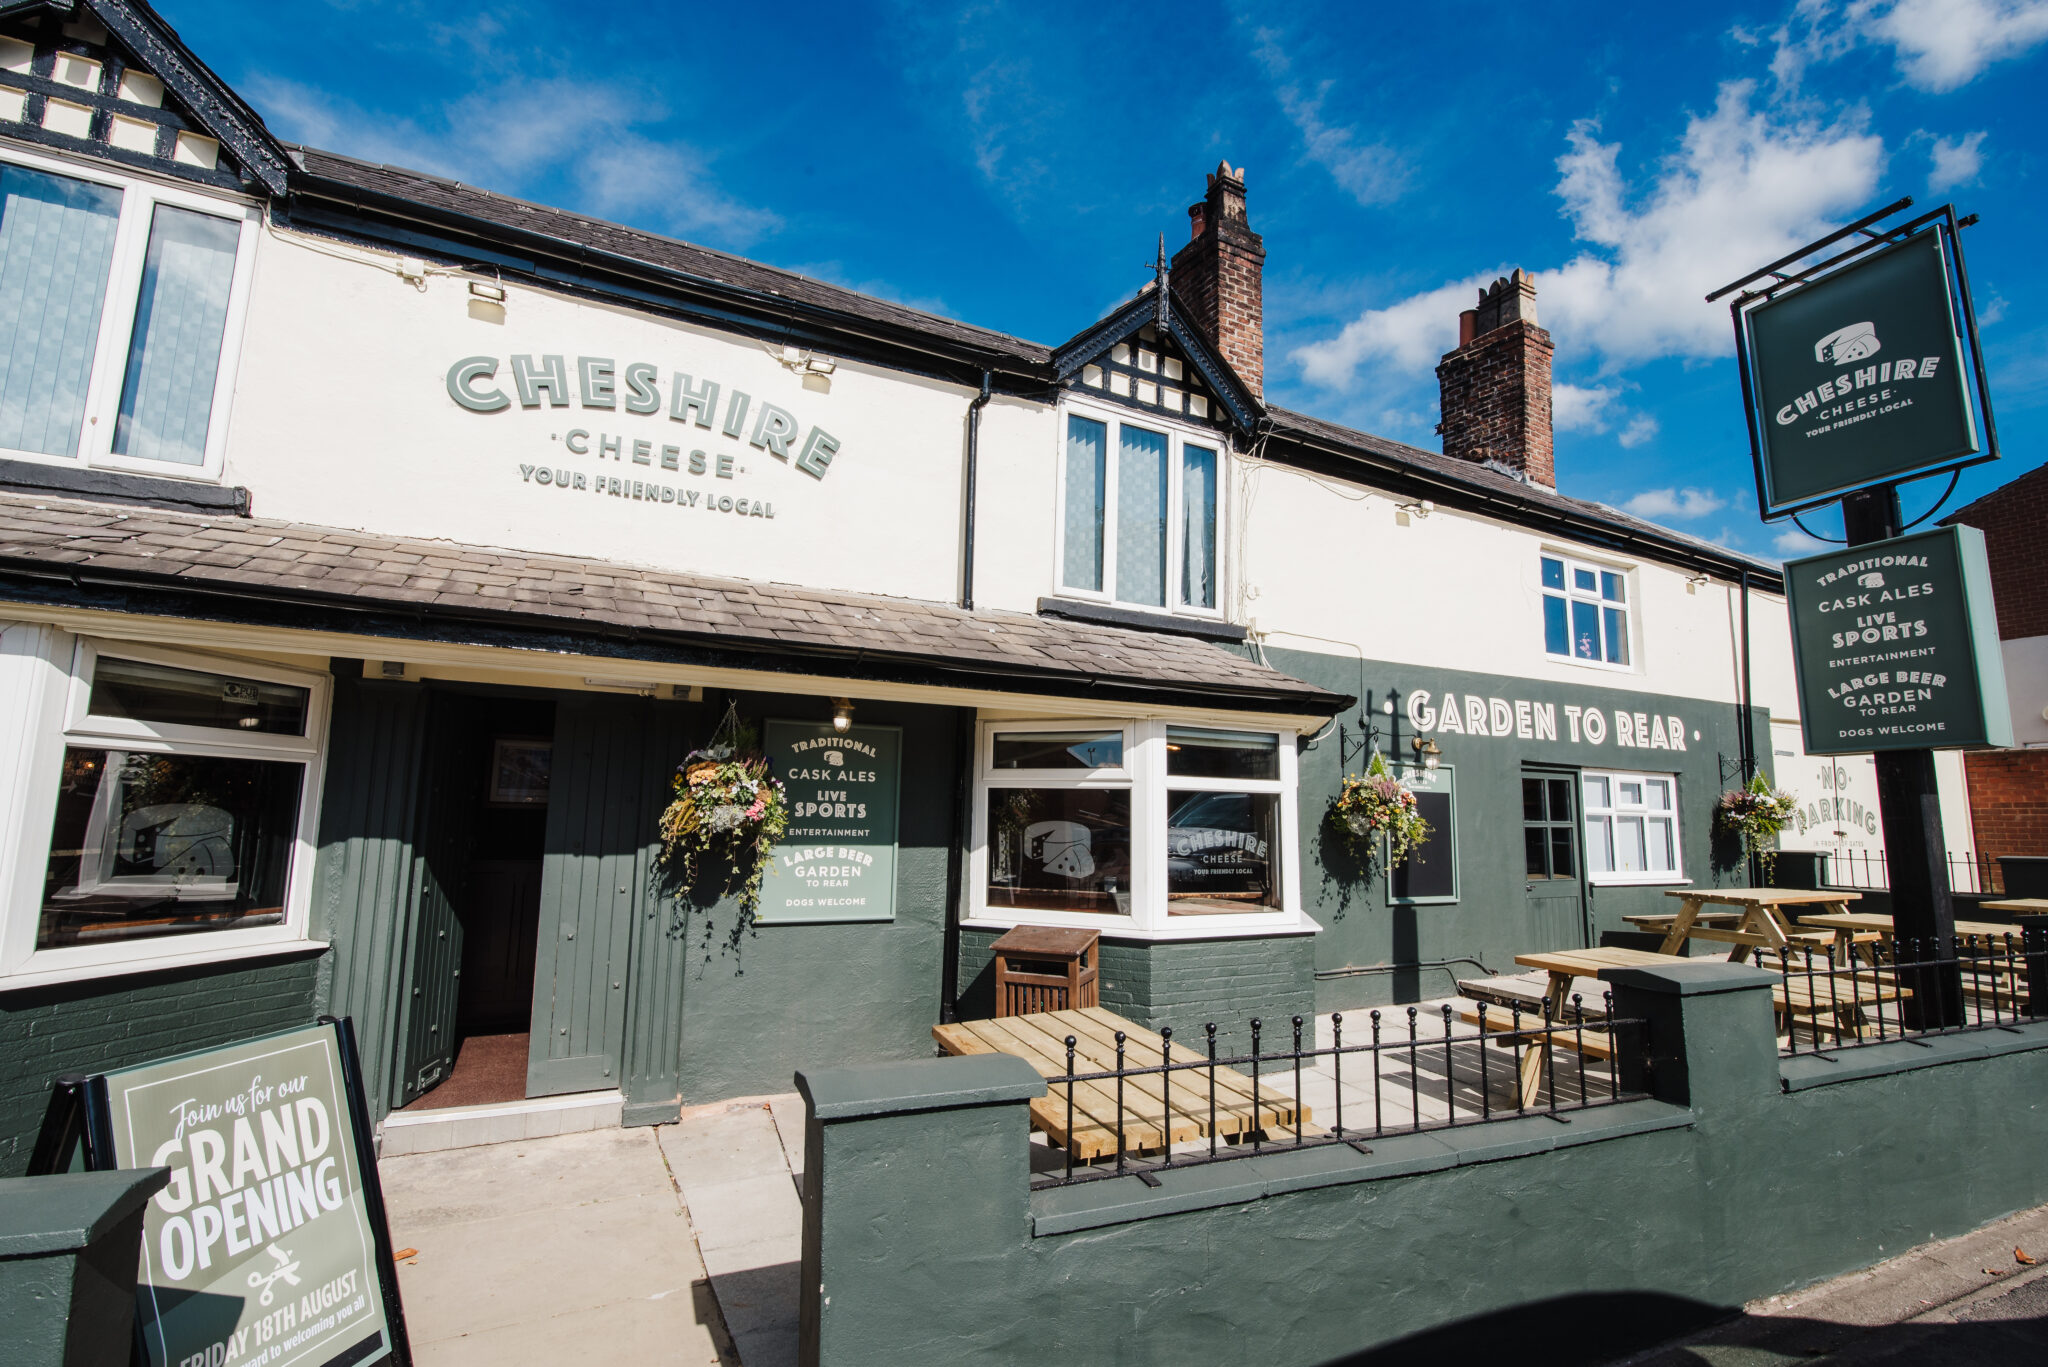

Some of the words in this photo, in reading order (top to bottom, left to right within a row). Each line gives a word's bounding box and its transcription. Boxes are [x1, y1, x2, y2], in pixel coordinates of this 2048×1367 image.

[1776, 356, 1941, 426] CHESHIRE
[1819, 389, 1891, 420] CHEESE
[445, 354, 841, 481] CHESHIRE
[1806, 425, 1831, 438] YOUR
[1833, 409, 1877, 430] FRIENDLY
[1880, 398, 1913, 415] LOCAL
[565, 428, 735, 479] CHEESE
[519, 463, 587, 491] YOUR
[595, 475, 701, 507] FRIENDLY
[706, 493, 776, 519] LOCAL
[1816, 555, 1929, 587] TRADITIONAL
[1818, 593, 1872, 613] CASK
[1879, 583, 1934, 603] ALES
[1857, 611, 1896, 628] LIVE
[1832, 620, 1928, 649] SPORTS
[1829, 646, 1936, 668] ENTERTAINMENT
[1827, 672, 1889, 699] LARGE
[1896, 671, 1947, 688] BEER
[1843, 688, 1932, 708] GARDEN
[1407, 689, 1557, 741] GARDEN
[1564, 705, 1606, 745] TO
[1614, 710, 1687, 751] REAR
[1859, 708, 1877, 717] TO
[1881, 704, 1916, 715] REAR
[1839, 728, 1874, 738] DOGS
[1878, 722, 1946, 735] WELCOME
[791, 737, 876, 758] TRADITIONAL
[788, 768, 831, 781] CASK
[837, 770, 876, 783] ALES
[1821, 766, 1847, 790] NO
[817, 790, 847, 802] LIVE
[794, 802, 867, 819] SPORTS
[1795, 797, 1877, 836] PARKING
[788, 828, 870, 837] ENTERTAINMENT
[1176, 830, 1268, 858] CHESHIRE
[783, 847, 834, 867] LARGE
[838, 847, 873, 867] BEER
[1202, 855, 1243, 864] CHEESE
[794, 866, 861, 877] GARDEN
[806, 879, 819, 887] TO
[823, 879, 849, 887] REAR
[1193, 868, 1210, 876] YOUR
[785, 899, 814, 907] DOGS
[817, 897, 866, 906] WELCOME
[169, 1098, 223, 1141] Join
[225, 1092, 249, 1116] us
[246, 1075, 274, 1113] for
[278, 1075, 309, 1098] our
[151, 1096, 330, 1214] GRAND
[159, 1156, 344, 1281] OPENING
[253, 1302, 297, 1346] 18TH
[300, 1268, 357, 1323] AUGUST
[270, 1343, 281, 1358] to
[283, 1314, 335, 1353] welcoming
[335, 1305, 353, 1326] you
[353, 1294, 366, 1312] all
